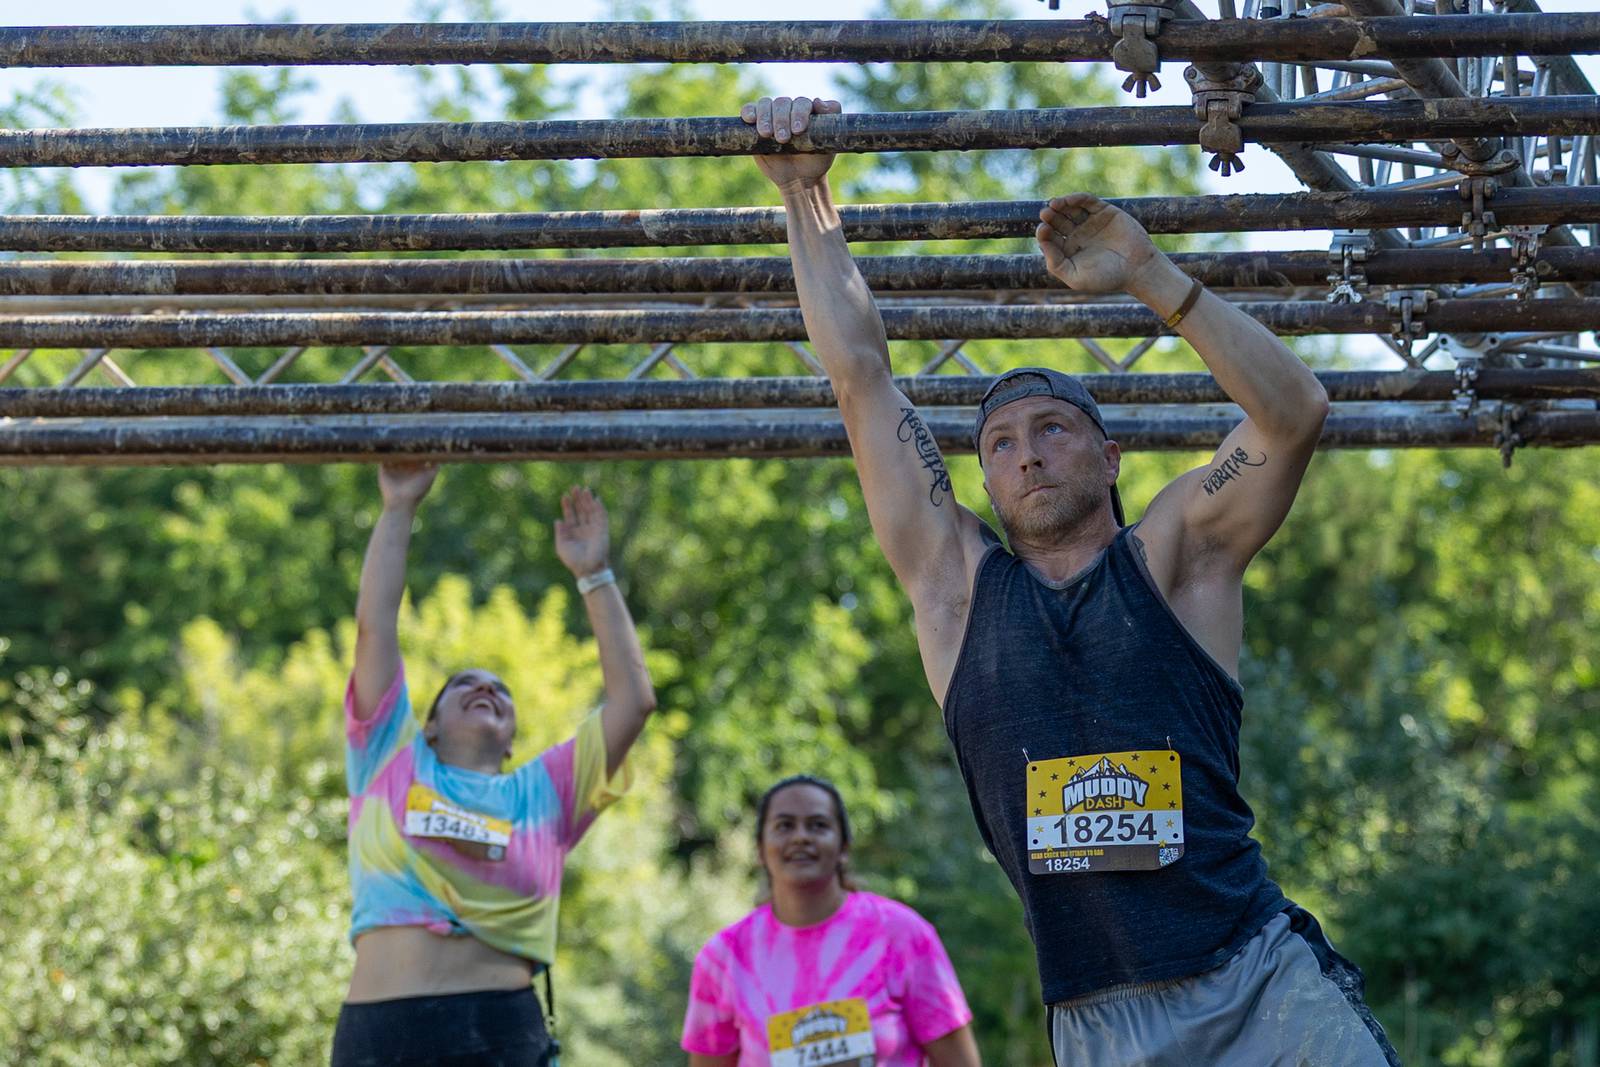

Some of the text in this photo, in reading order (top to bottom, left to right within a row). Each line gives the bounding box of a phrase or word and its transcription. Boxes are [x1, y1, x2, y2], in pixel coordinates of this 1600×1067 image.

[897, 408, 952, 507] AEQUITAS
[1201, 446, 1267, 496] VERITAS
[1064, 777, 1149, 813] MUDDY
[1086, 797, 1123, 810] DASH
[1053, 813, 1157, 844] 18254
[1045, 857, 1090, 872] 18254
[794, 1037, 849, 1066] 7444
